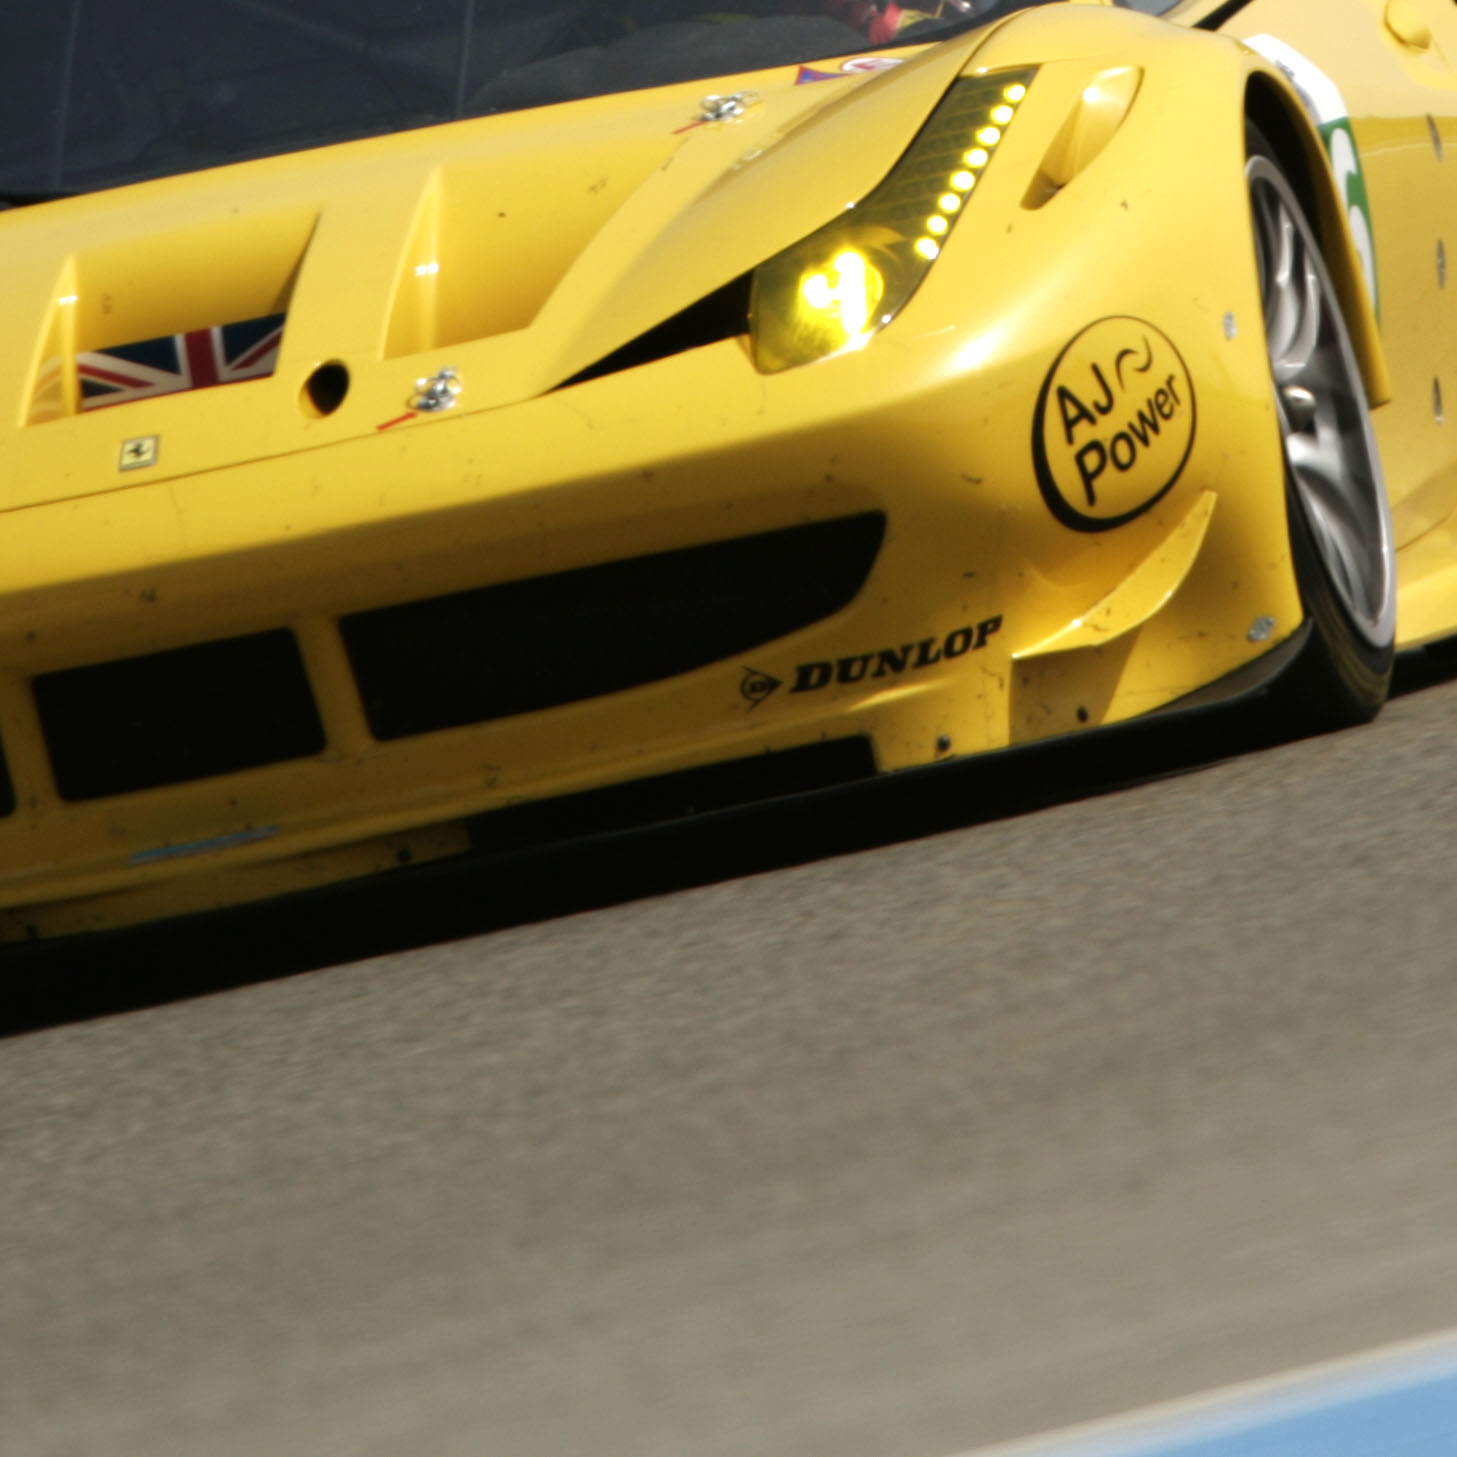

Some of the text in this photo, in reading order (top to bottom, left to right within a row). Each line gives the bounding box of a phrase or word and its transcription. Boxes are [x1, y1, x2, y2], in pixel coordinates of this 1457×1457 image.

[1056, 361, 1115, 446] AJ
[1074, 374, 1182, 508] Power
[789, 614, 1004, 695] DUNLOP
